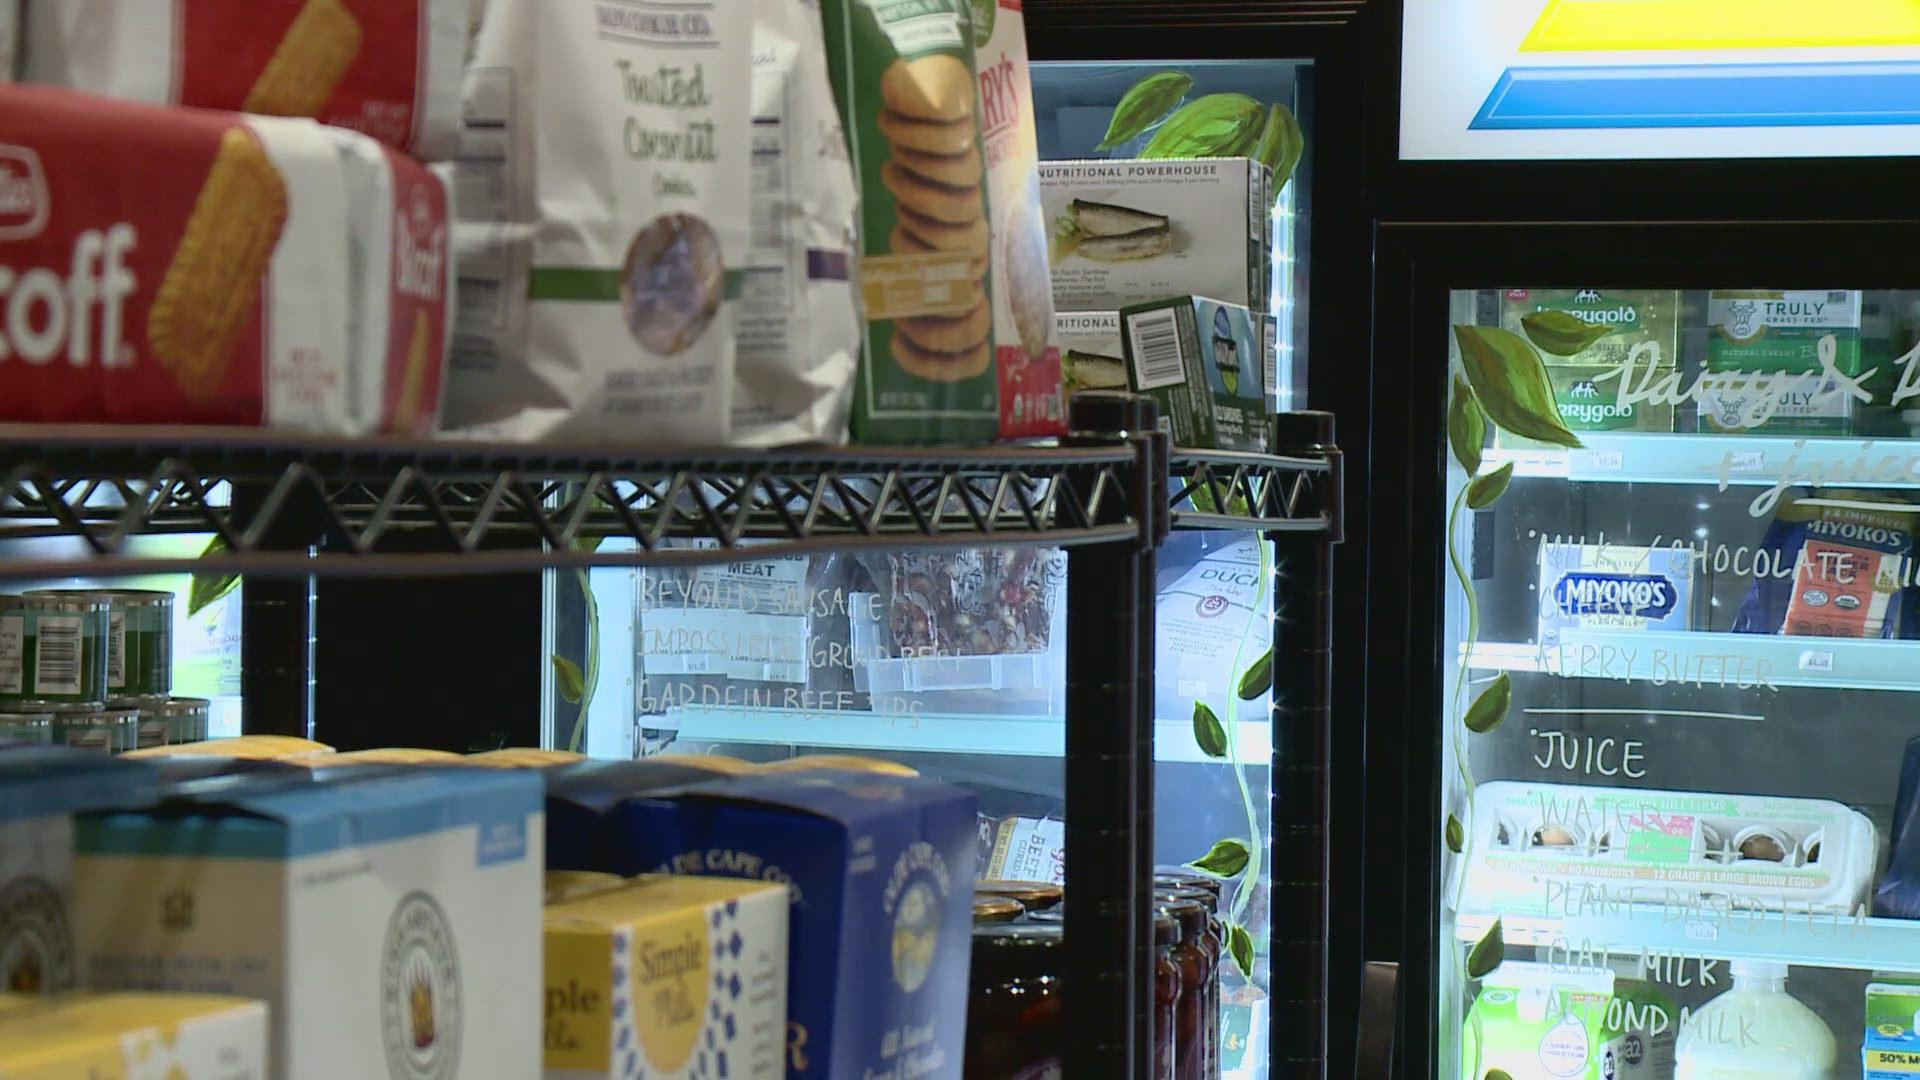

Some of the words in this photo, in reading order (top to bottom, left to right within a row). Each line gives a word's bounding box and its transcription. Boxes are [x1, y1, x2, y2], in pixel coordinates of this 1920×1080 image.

[979, 53, 1019, 130] RY'S
[1128, 165, 1217, 176] POWERHOUSE
[0, 222, 137, 368] off
[1764, 302, 1824, 315] TRULY
[1057, 319, 1116, 328] RITIONAL
[1592, 341, 1814, 428] Dairy
[1816, 334, 1878, 404] &
[1557, 400, 1632, 422] rrygold
[1808, 519, 1902, 547] MIYOKO'S
[728, 562, 775, 577] MEAT
[1537, 531, 1619, 571] MILK
[1669, 538, 1854, 585] CHOCOLATE
[640, 576, 758, 617] BEYOND
[769, 586, 882, 621] SAUSAE
[1566, 579, 1666, 607] MIYOKO'S
[1653, 648, 1779, 692] BUTTER
[638, 680, 771, 718] GARDEIN
[784, 687, 853, 719] BEEF
[1535, 731, 1647, 778] JUICE
[1012, 840, 1028, 872] CURED
[1022, 832, 1045, 878] BEEF
[1654, 868, 1665, 879] 12
[1668, 871, 1701, 881] GRADE
[1704, 872, 1711, 882] A
[1714, 872, 1745, 884] LARGE
[1748, 876, 1785, 887] BROWN
[1788, 876, 1815, 888] EGGS
[1637, 945, 1718, 987] MILK
[1545, 988, 1669, 1037] ALMOND
[1678, 1006, 1759, 1048] MILK
[1880, 1053, 1906, 1065] 50%
[1908, 1055, 1920, 1065] M
